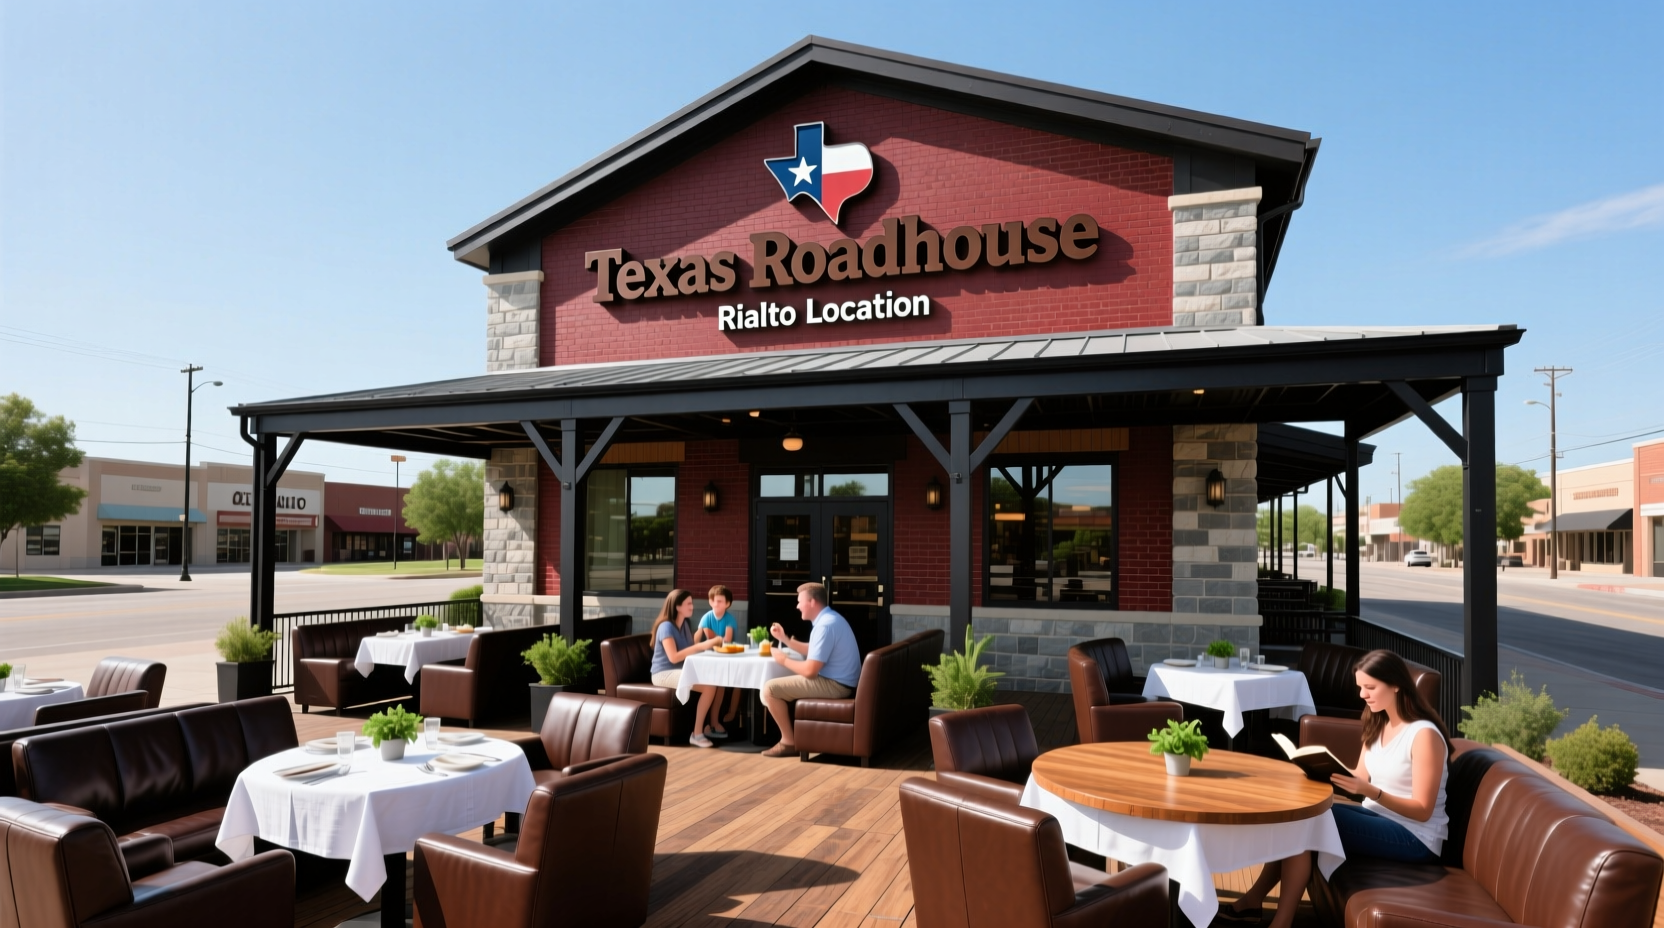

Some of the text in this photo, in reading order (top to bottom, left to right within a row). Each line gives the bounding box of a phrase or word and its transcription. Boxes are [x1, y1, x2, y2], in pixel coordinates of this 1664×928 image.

[585, 213, 1100, 303] Texas Roadhouse
[717, 290, 931, 331] Rialto Location
